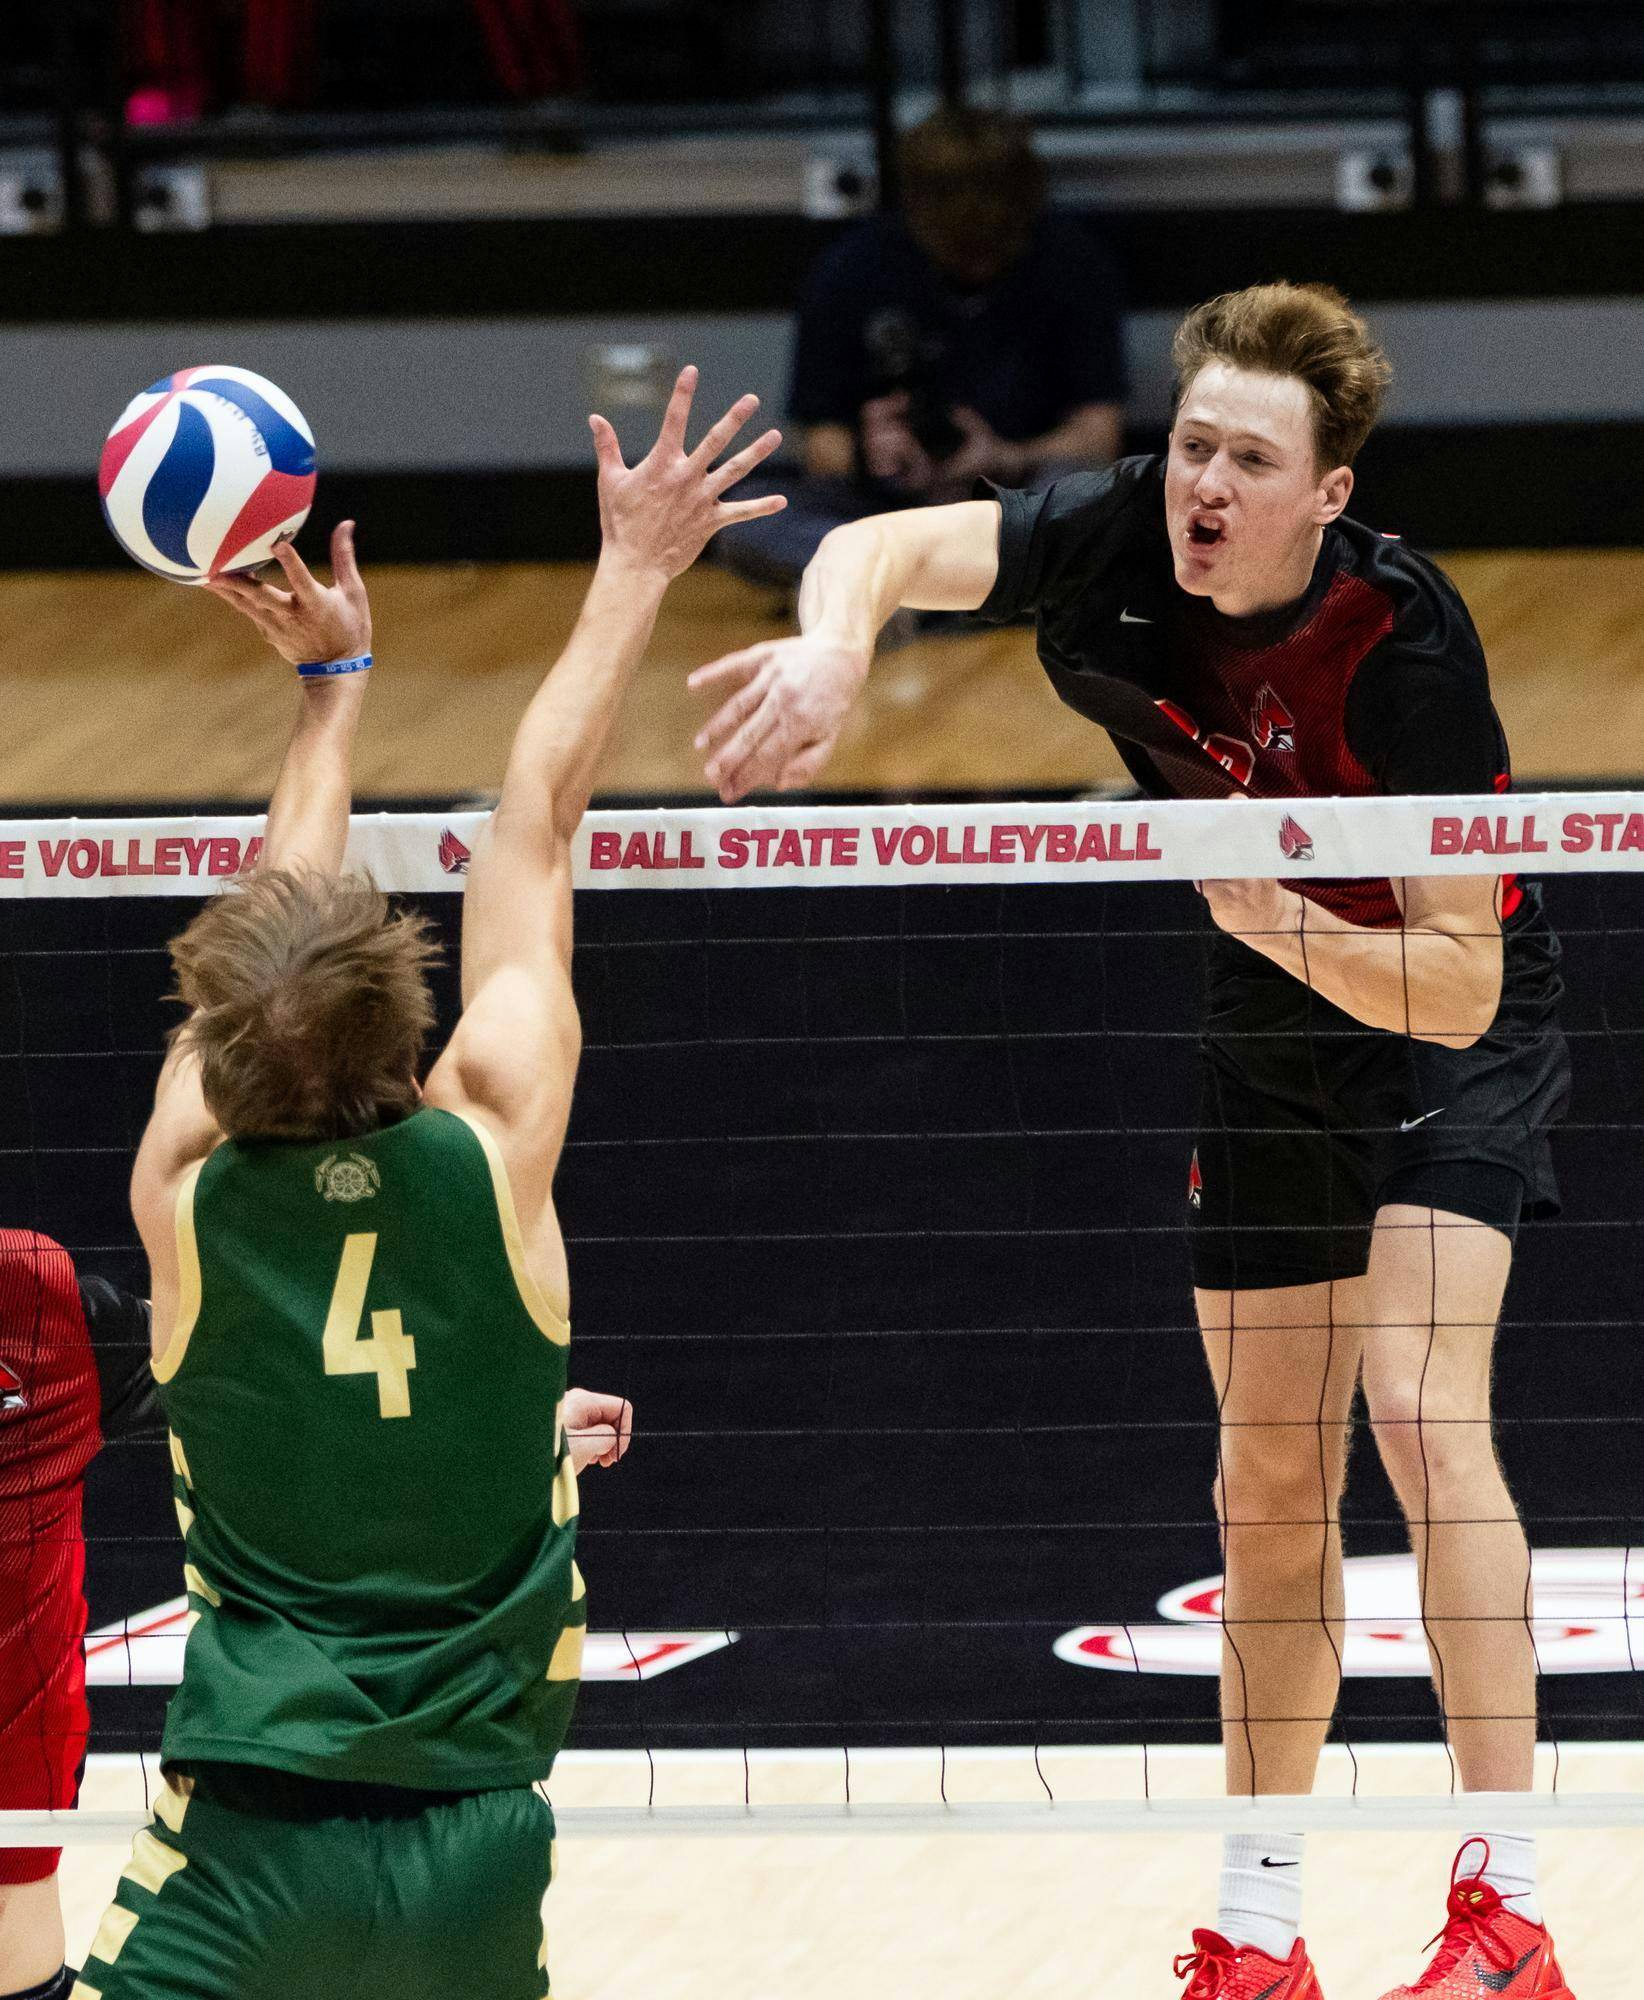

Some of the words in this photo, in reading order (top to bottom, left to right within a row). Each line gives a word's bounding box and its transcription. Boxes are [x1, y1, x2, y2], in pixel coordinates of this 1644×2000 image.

[589, 831, 705, 870] BALL
[717, 827, 860, 869] STATE
[872, 822, 1162, 866] VOLLEYBALL
[1430, 815, 1548, 855] BALL
[1560, 812, 1644, 853] STA
[0, 840, 26, 879] E
[322, 1232, 417, 1419] 4
